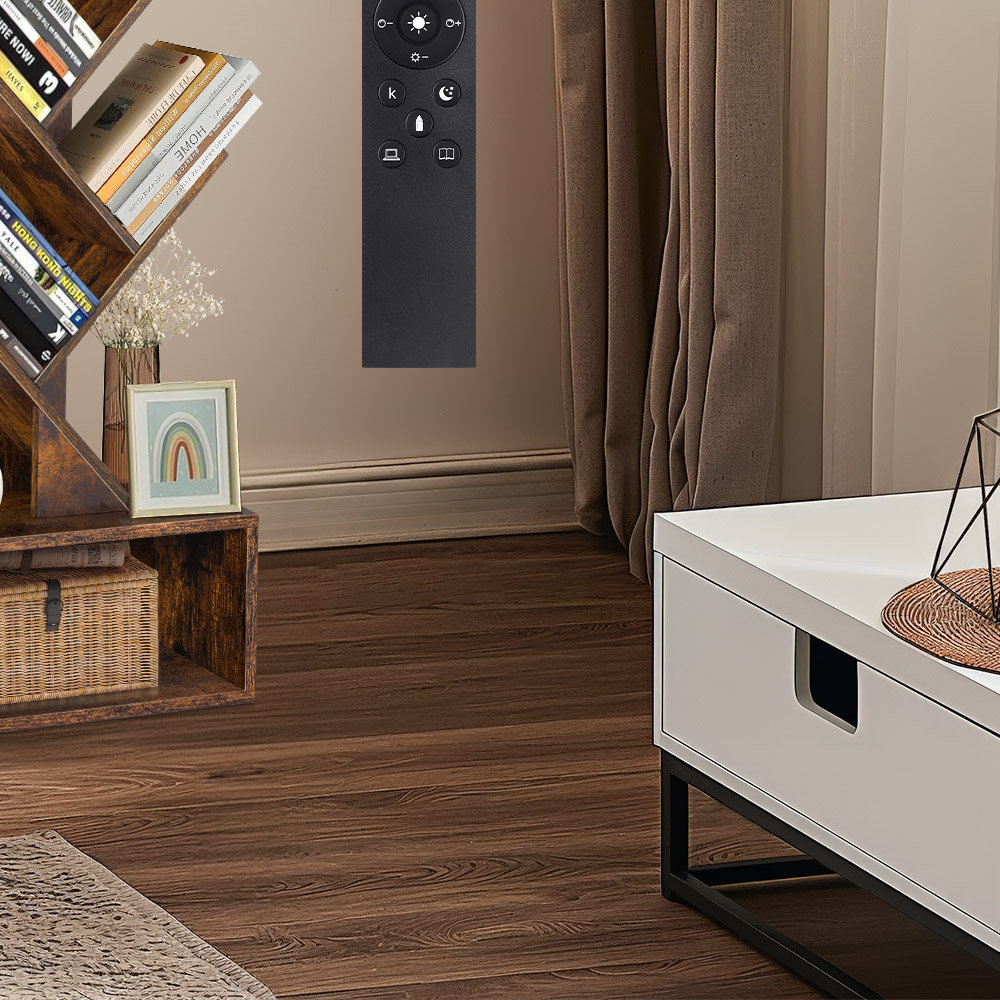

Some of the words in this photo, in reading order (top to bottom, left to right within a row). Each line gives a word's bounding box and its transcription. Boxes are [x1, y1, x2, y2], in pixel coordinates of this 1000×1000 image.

[12, 221, 38, 250] HONG
[37, 248, 62, 279] KONG
[61, 276, 92, 313] NIGHTS
